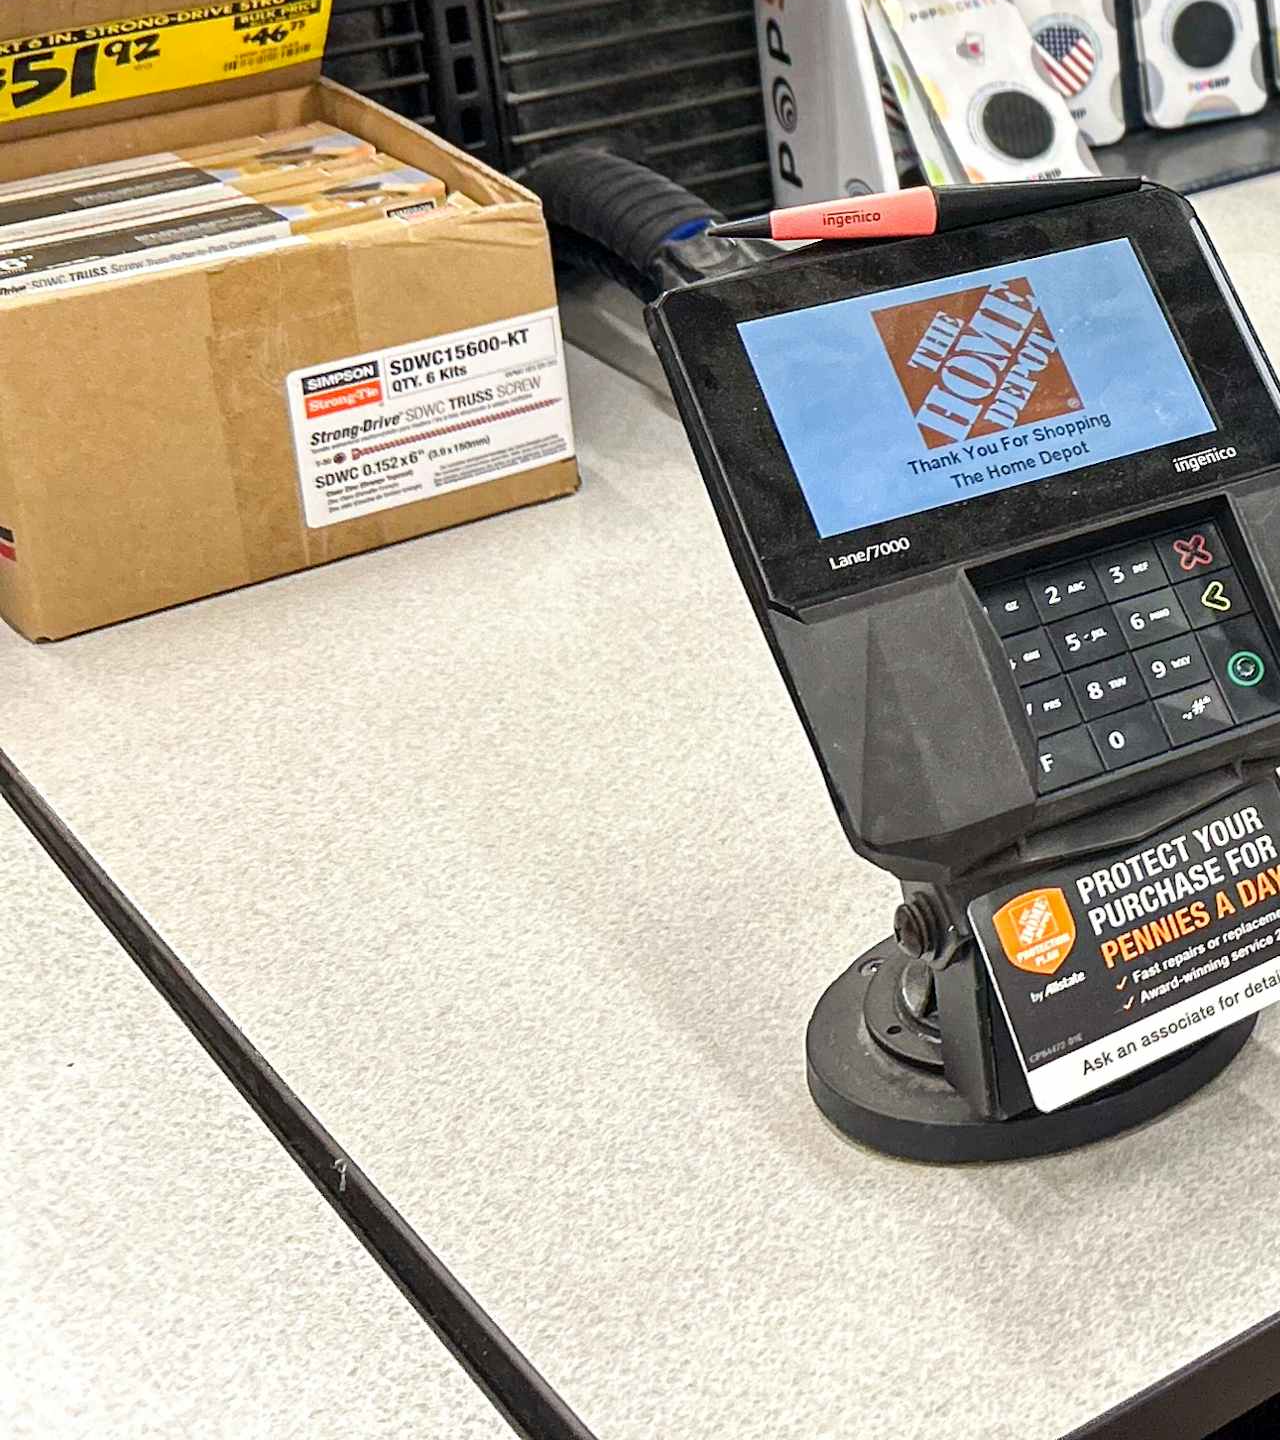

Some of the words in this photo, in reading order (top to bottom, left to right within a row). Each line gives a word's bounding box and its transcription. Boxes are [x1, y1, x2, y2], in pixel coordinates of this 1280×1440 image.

[49, 31, 79, 45] IN.
[85, 3, 234, 39] STRONG-DRIVE
[822, 209, 882, 227] ingenico
[389, 328, 530, 377] SDWC15600-KT
[907, 311, 965, 373] THE
[306, 365, 375, 391] SIMPSON
[914, 280, 1039, 442] HOME
[392, 375, 423, 393] QTY.
[426, 372, 436, 384] 6
[439, 365, 468, 381] Kits
[448, 388, 494, 410] TRUSS
[496, 375, 542, 398] SCREW
[985, 327, 1058, 430] DEPOT
[308, 385, 380, 413] Strong-Tie
[907, 451, 961, 477] Thank
[962, 439, 1000, 463] You
[1001, 433, 1030, 453] For
[1032, 412, 1112, 446] Shopping
[1172, 445, 1238, 474] ingenico
[315, 466, 360, 490] SDWC
[362, 456, 399, 477] 0.152
[949, 470, 985, 491] The
[986, 458, 1037, 483] Home
[1039, 440, 1092, 470] Depot
[827, 535, 912, 572] Lane/7000
[1067, 580, 1088, 594] ABC
[1108, 565, 1126, 584] 3
[1044, 585, 1062, 606] 2
[1129, 611, 1146, 631] 6
[1064, 632, 1082, 652] 5
[1150, 659, 1168, 679] 9
[1086, 681, 1104, 701] 8
[1107, 730, 1126, 750] 0
[1039, 752, 1055, 774] F
[1075, 835, 1191, 905] PROTECT
[1192, 804, 1265, 863] YOUR
[1087, 857, 1226, 936] PURCHASE
[1227, 835, 1279, 883] FOR
[1100, 900, 1212, 970] PENNIES
[1215, 891, 1237, 920] A
[1131, 965, 1162, 984] Fast
[1162, 942, 1207, 973] repairs
[1207, 935, 1222, 949] or
[1139, 954, 1230, 1005] Award-winning
[1230, 935, 1274, 963] service
[1029, 991, 1046, 1004] by
[1045, 971, 1087, 998] Allstate
[1082, 1052, 1114, 1076] Ask
[1117, 1041, 1138, 1060] an
[1140, 1003, 1216, 1048] associate
[1218, 989, 1241, 1011] for
